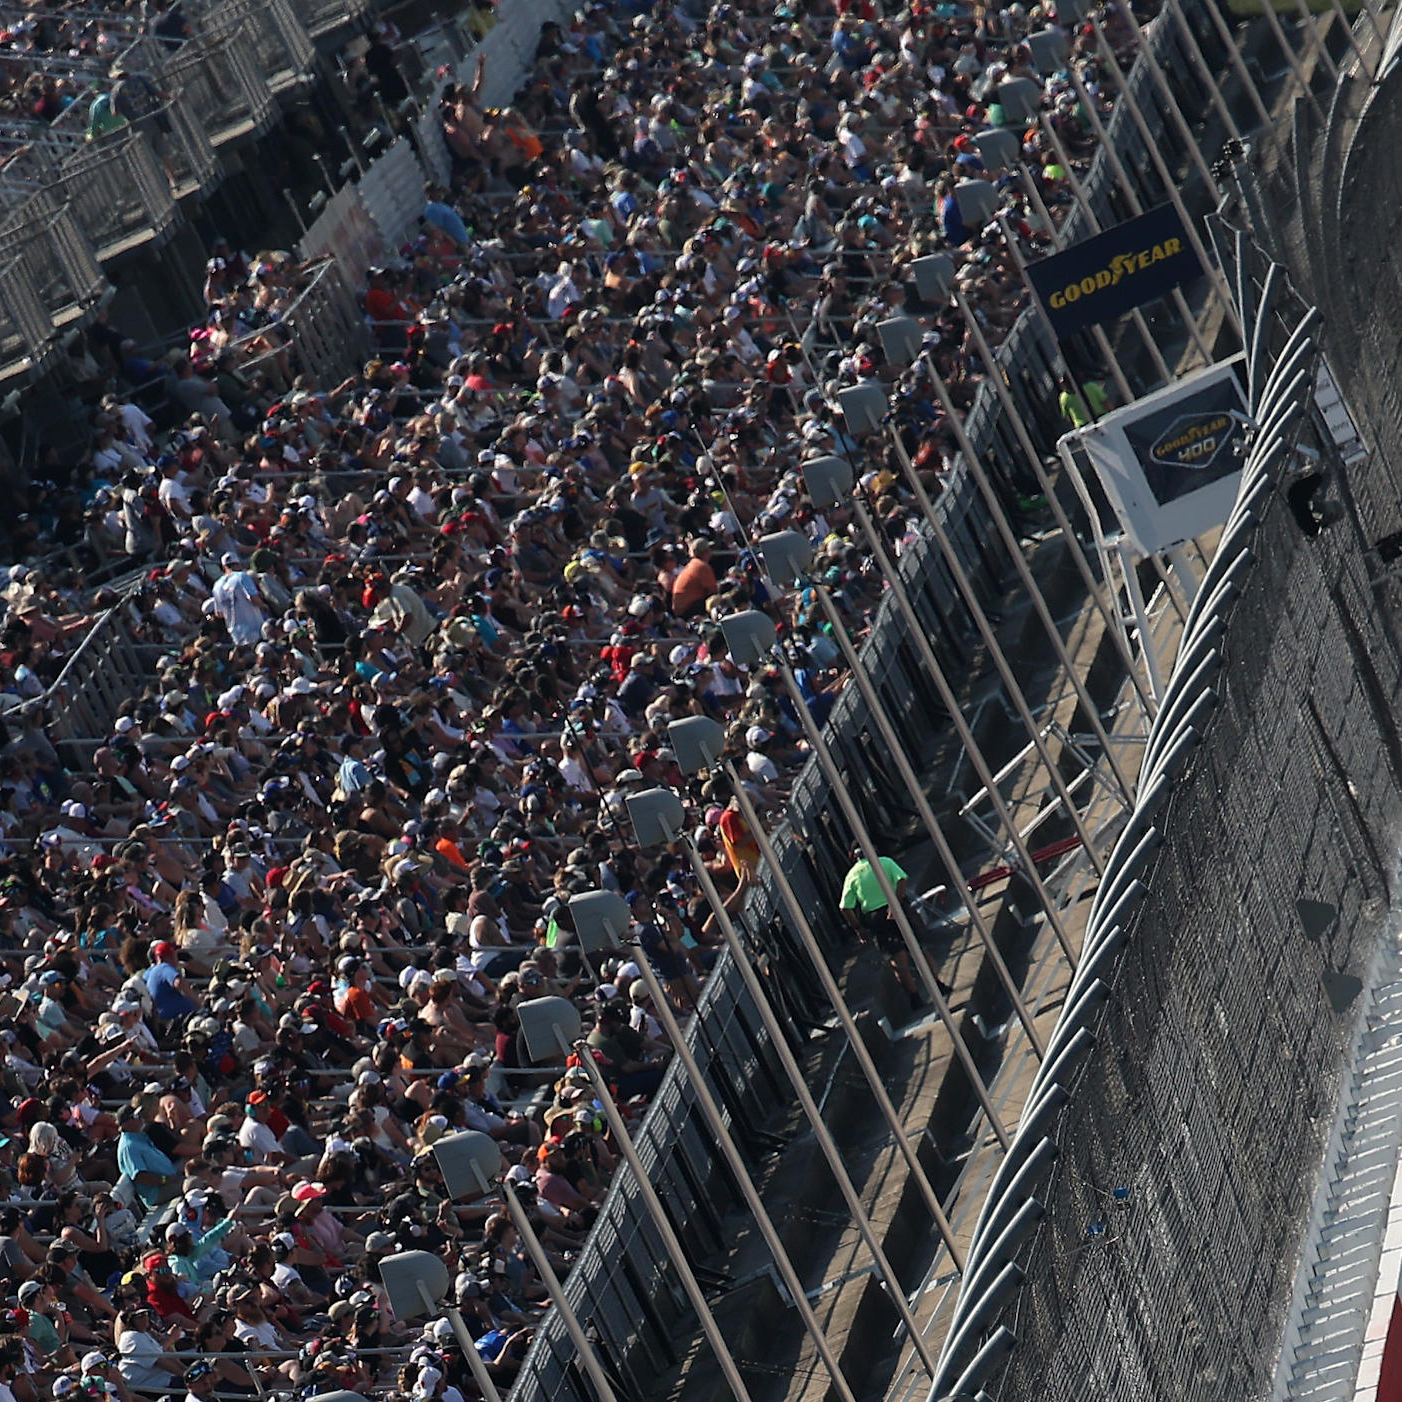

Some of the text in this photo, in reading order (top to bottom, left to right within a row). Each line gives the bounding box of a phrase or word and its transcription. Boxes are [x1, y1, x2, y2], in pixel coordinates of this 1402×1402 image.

[1049, 237, 1181, 309] GOODYEAR
[1156, 417, 1227, 456] GOODYEAR
[1178, 437, 1216, 461] 400
